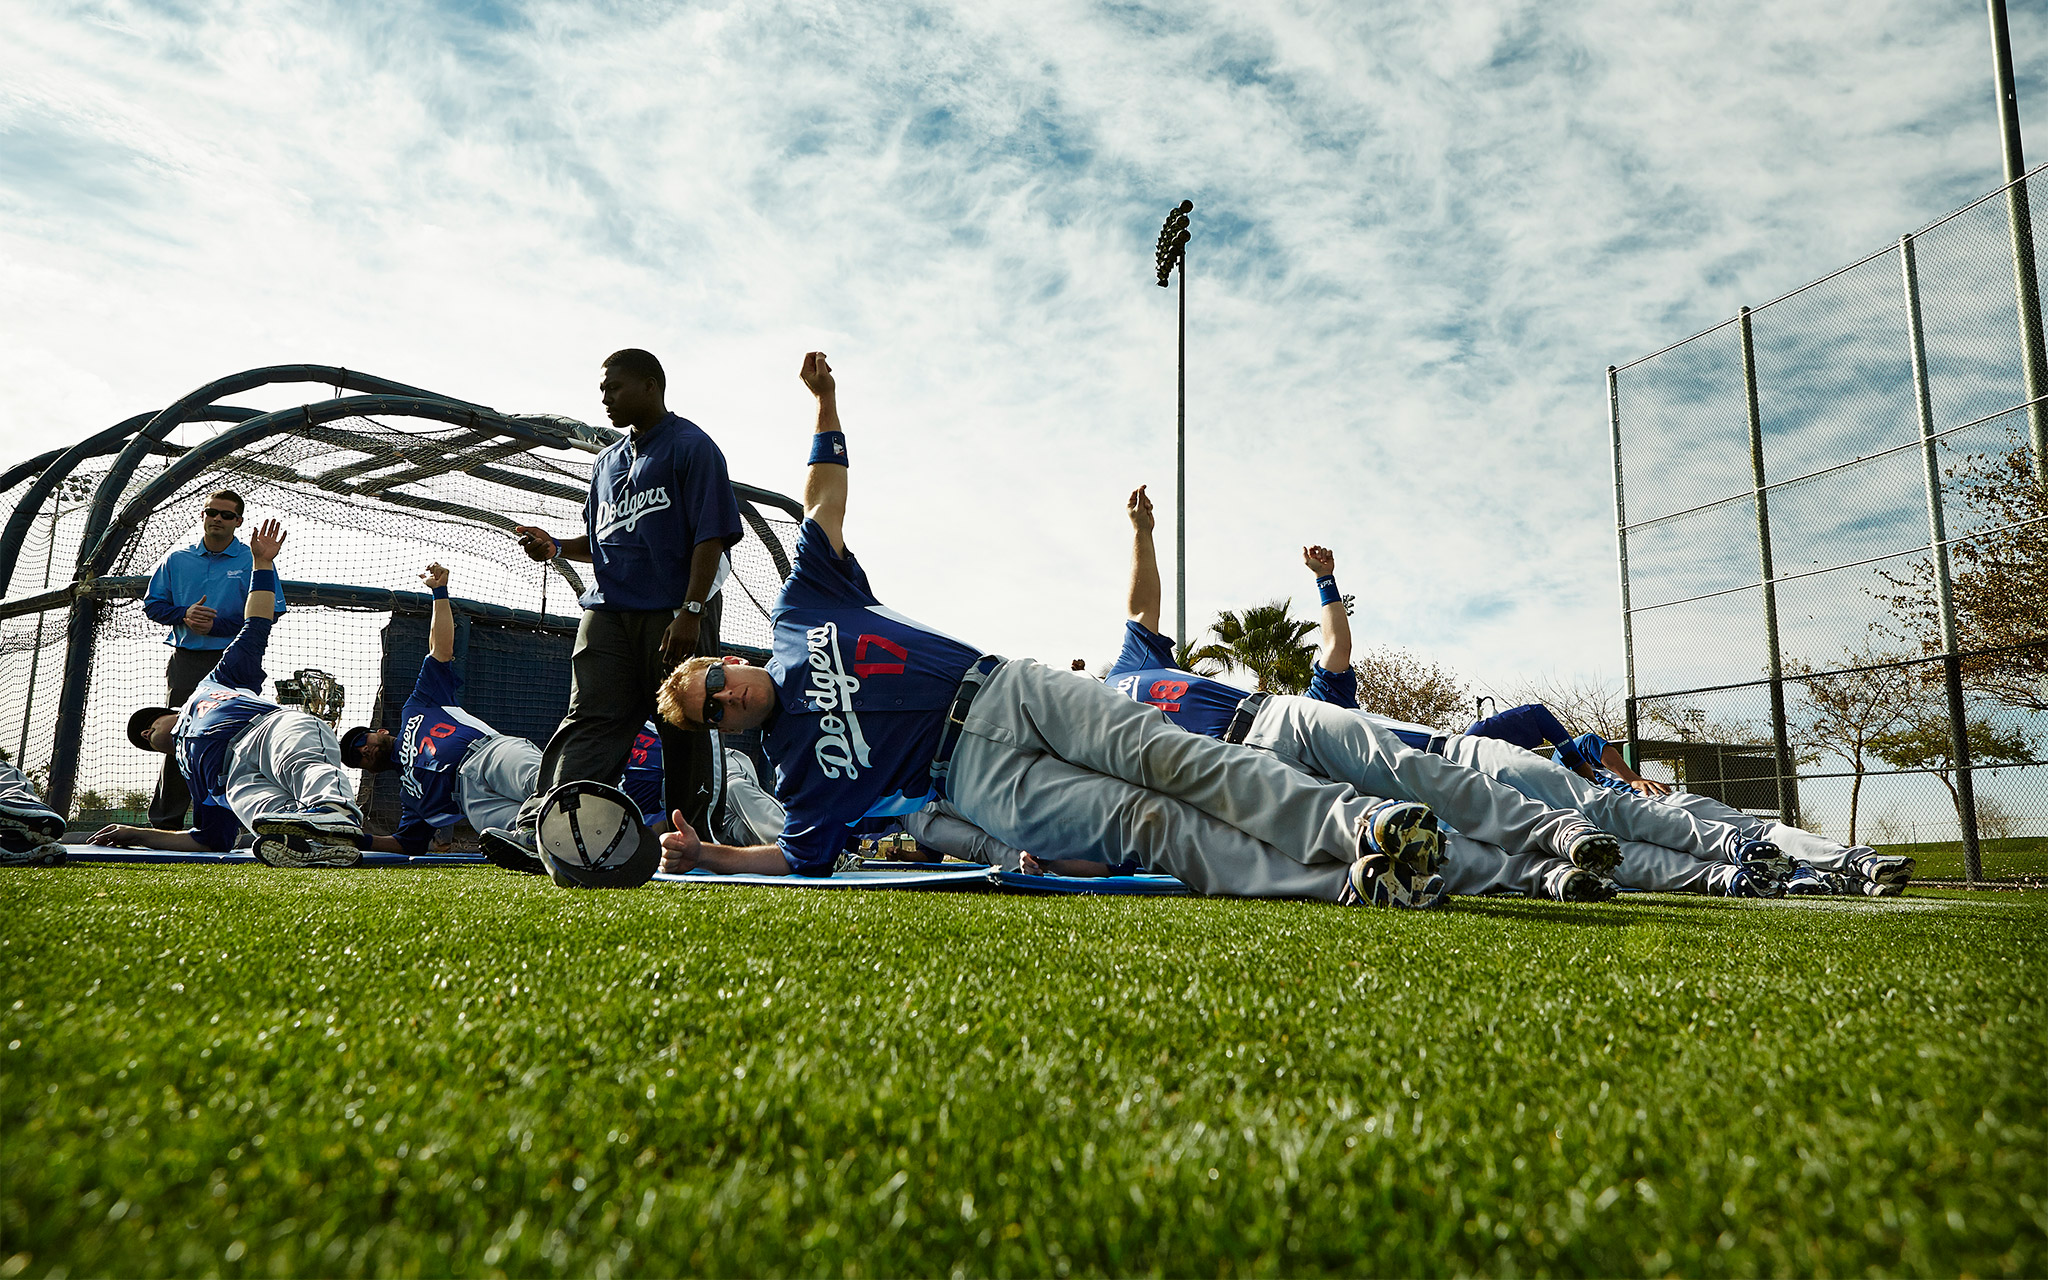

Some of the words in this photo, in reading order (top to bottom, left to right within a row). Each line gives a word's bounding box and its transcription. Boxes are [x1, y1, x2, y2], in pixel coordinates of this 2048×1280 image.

[595, 486, 671, 542] Dodgers
[853, 633, 908, 679] 17
[805, 621, 873, 781] Dodgers
[1144, 679, 1190, 713] 18
[399, 713, 425, 800] Dodgers
[418, 722, 457, 757] 70
